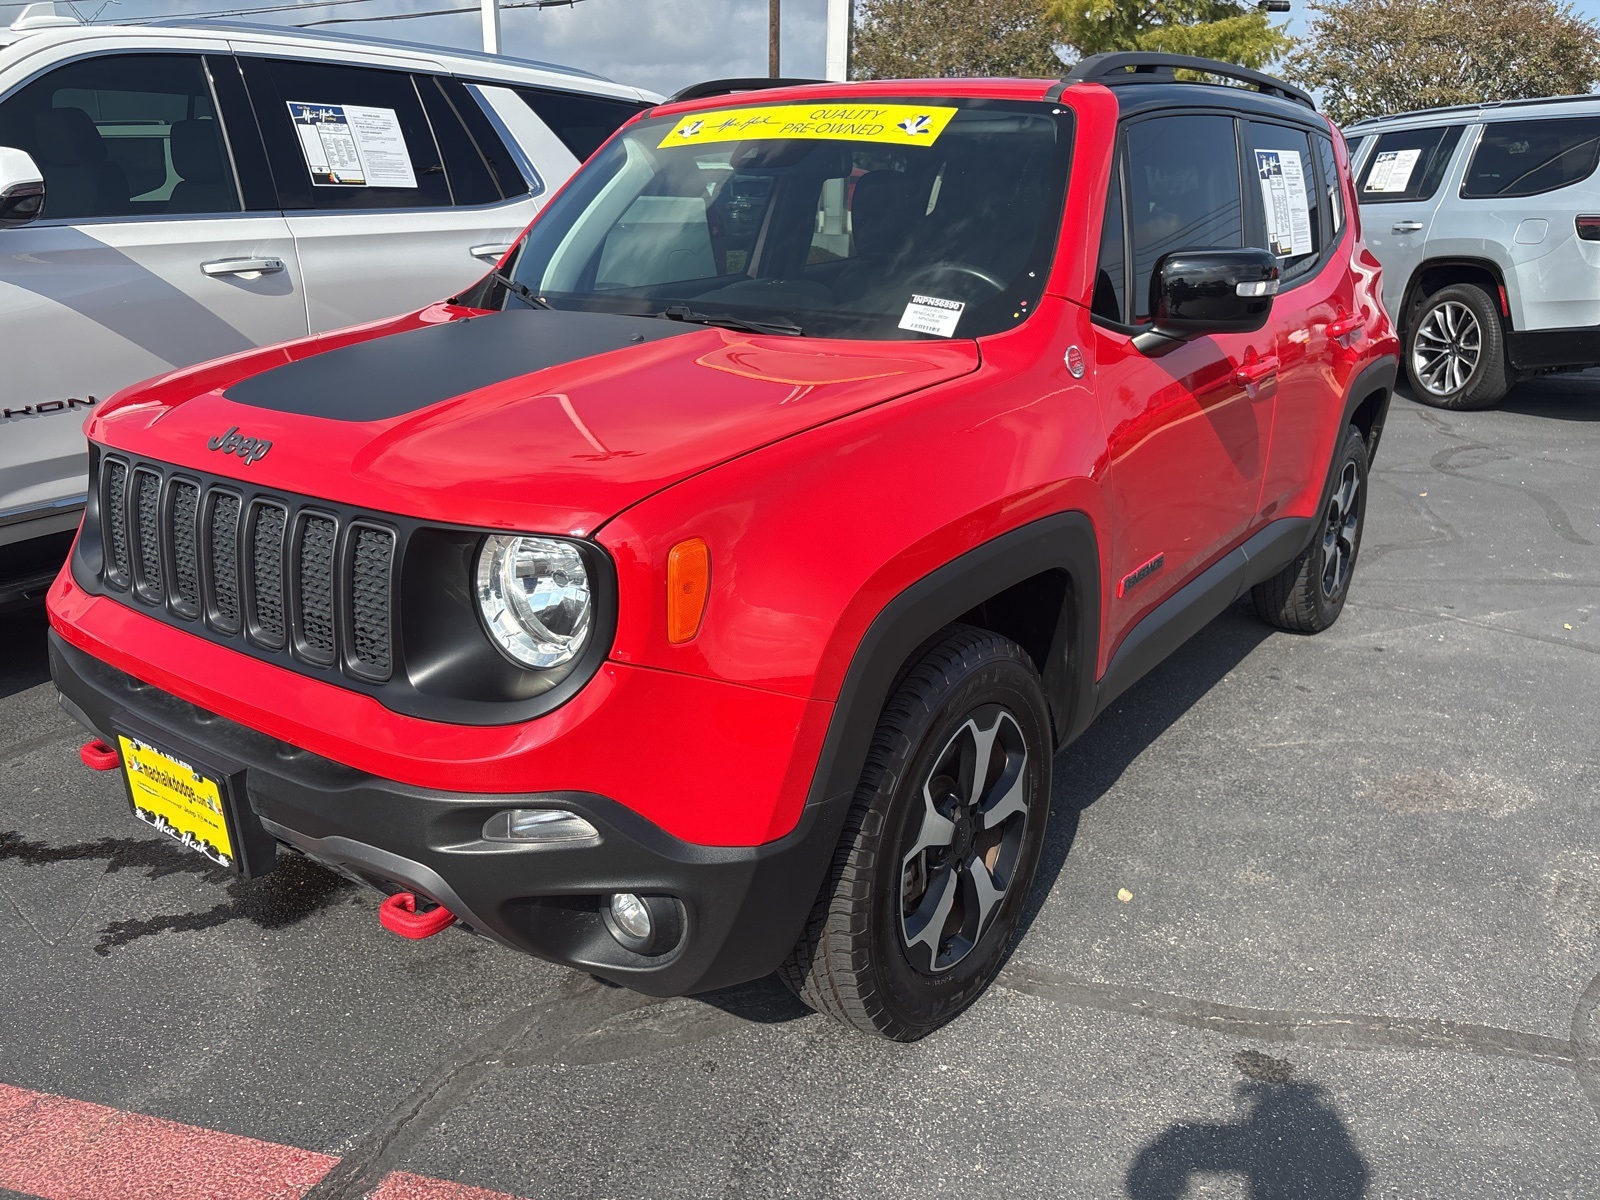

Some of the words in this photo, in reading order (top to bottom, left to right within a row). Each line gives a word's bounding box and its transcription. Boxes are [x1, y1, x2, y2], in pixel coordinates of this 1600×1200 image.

[810, 109, 887, 120] QUALITY
[779, 122, 884, 136] PRE-OWNED
[208, 426, 273, 466] Jeep
